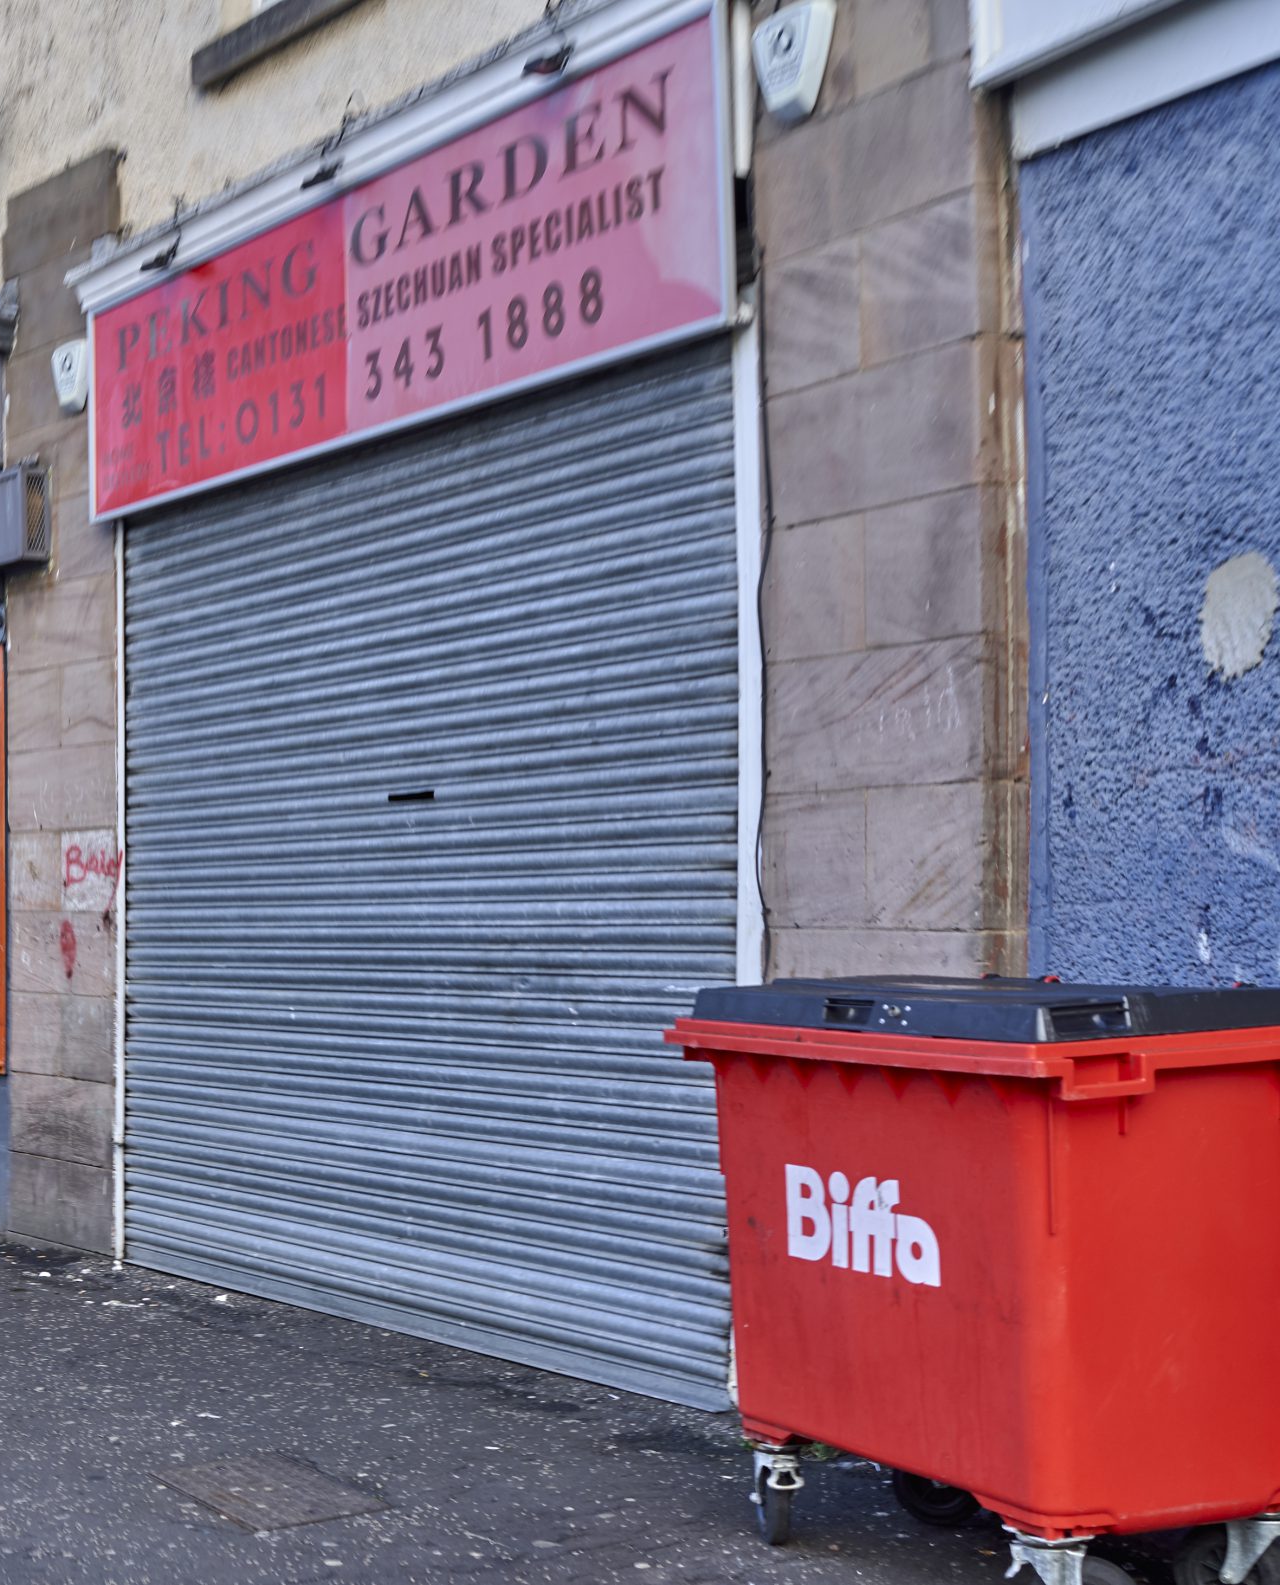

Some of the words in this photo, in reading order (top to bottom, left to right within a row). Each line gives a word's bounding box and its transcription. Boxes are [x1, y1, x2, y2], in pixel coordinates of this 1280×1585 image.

[117, 240, 317, 372] PEKING
[349, 64, 675, 267] GARDEN
[226, 303, 351, 381] CANTONESE
[357, 242, 482, 331] SZECHUAN
[492, 165, 665, 275] SPECIALIST
[365, 322, 445, 401] 343
[478, 265, 604, 362] 1888
[784, 1163, 941, 1287] Biffa
